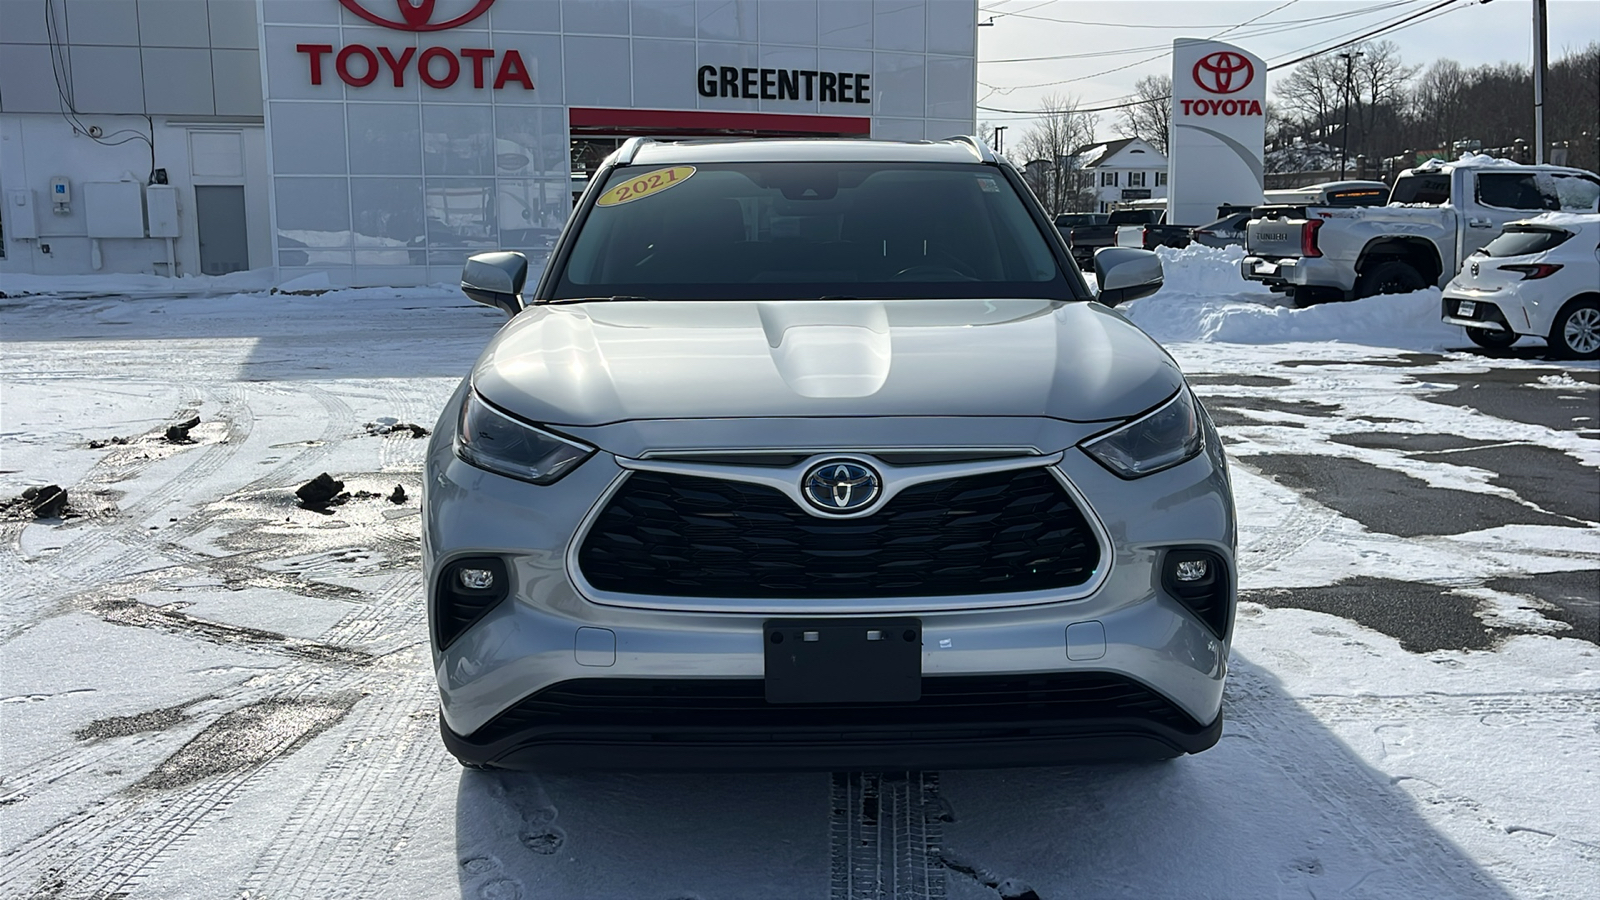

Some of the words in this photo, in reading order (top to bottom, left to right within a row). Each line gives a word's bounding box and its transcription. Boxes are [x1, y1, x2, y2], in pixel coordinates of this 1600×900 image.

[296, 44, 535, 90] TOYOTA
[697, 65, 871, 104] GREENTREE
[1180, 99, 1263, 116] TOYOTA
[616, 169, 679, 202] 2021
[1256, 232, 1288, 241] TUNDRA
